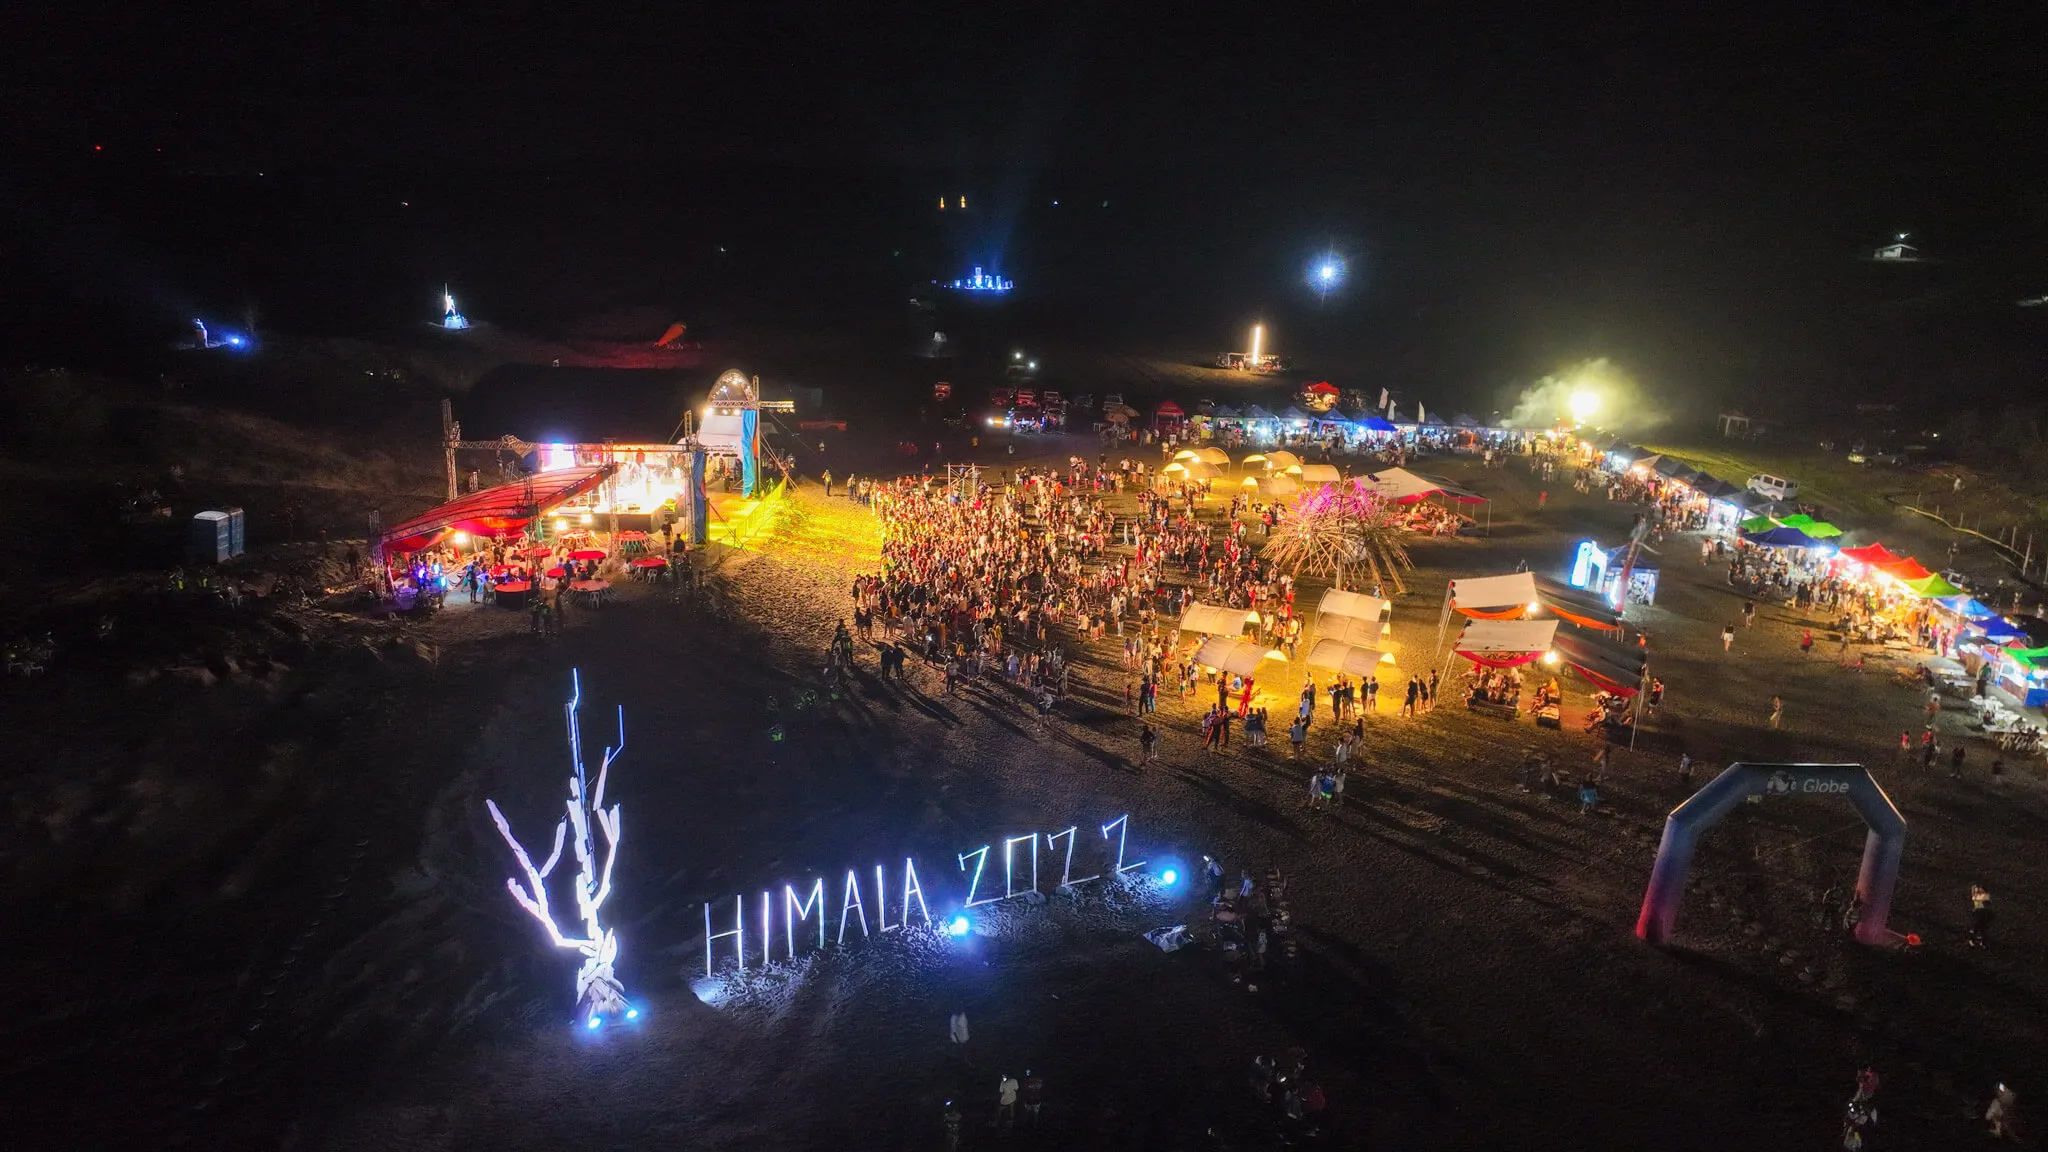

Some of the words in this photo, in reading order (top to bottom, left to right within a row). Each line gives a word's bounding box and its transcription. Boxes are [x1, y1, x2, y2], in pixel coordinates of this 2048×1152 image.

[1803, 779, 1849, 793] Globe
[704, 858, 930, 978] HIMALA
[957, 814, 1147, 908] 2022
